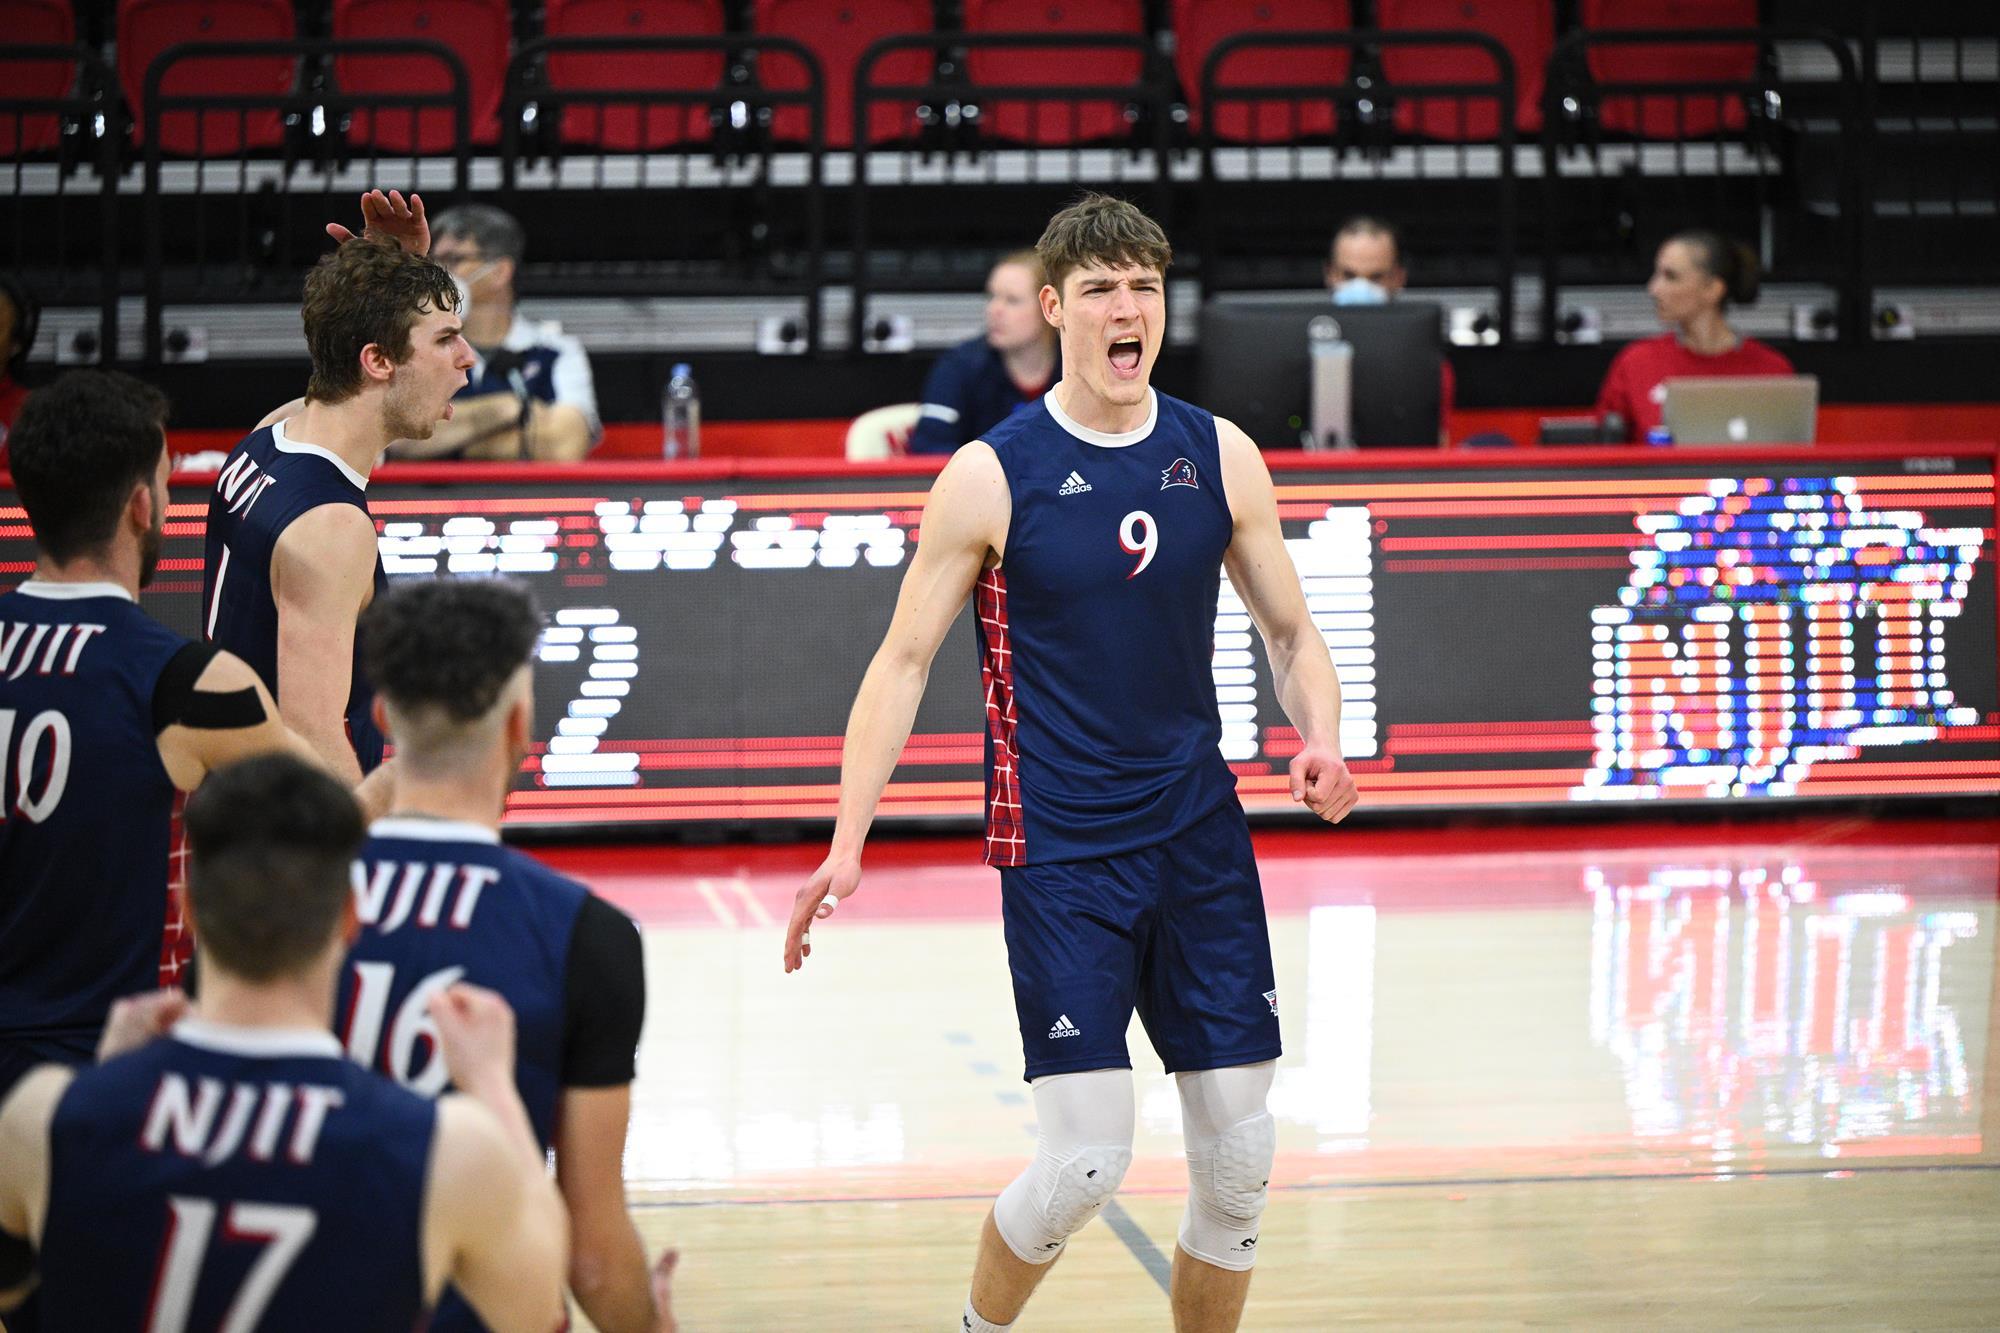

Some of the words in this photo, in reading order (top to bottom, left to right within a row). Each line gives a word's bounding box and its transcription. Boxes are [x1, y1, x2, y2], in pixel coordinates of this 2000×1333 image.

[1058, 483, 1093, 496] adidas
[207, 543, 231, 642] 1
[1118, 510, 1159, 580] 9
[538, 608, 641, 787] 2
[341, 960, 466, 1098] 16
[1048, 1028, 1081, 1040] adidas
[138, 1070, 346, 1168] NJIT
[143, 1196, 319, 1333] 17
